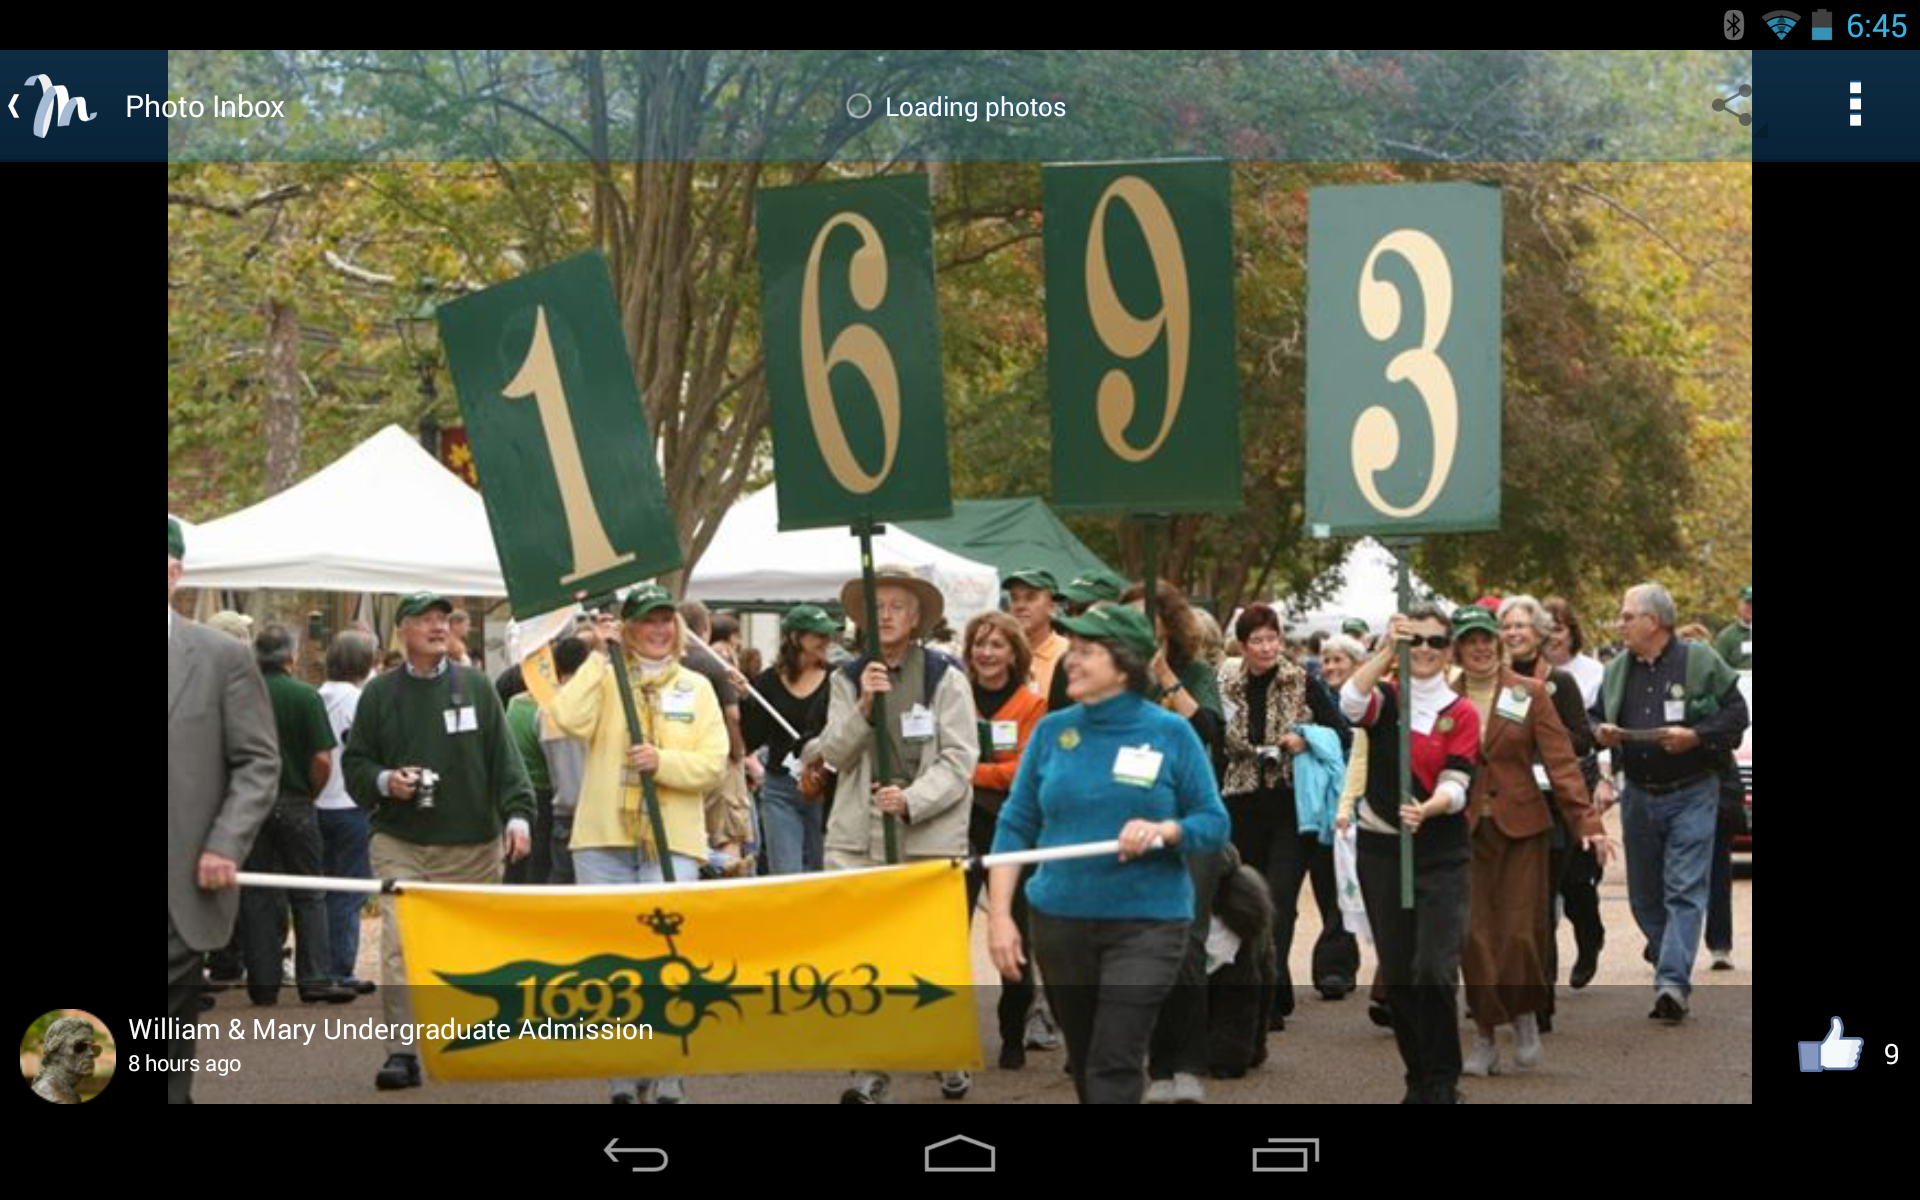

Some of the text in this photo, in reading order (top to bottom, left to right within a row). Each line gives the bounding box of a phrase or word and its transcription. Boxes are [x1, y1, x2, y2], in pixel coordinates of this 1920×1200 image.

[502, 304, 635, 584] 1
[800, 211, 901, 494] 6
[1085, 175, 1191, 463] 9
[1350, 228, 1460, 518] 3
[515, 968, 644, 1024] 1693
[765, 963, 883, 1018] 1963
